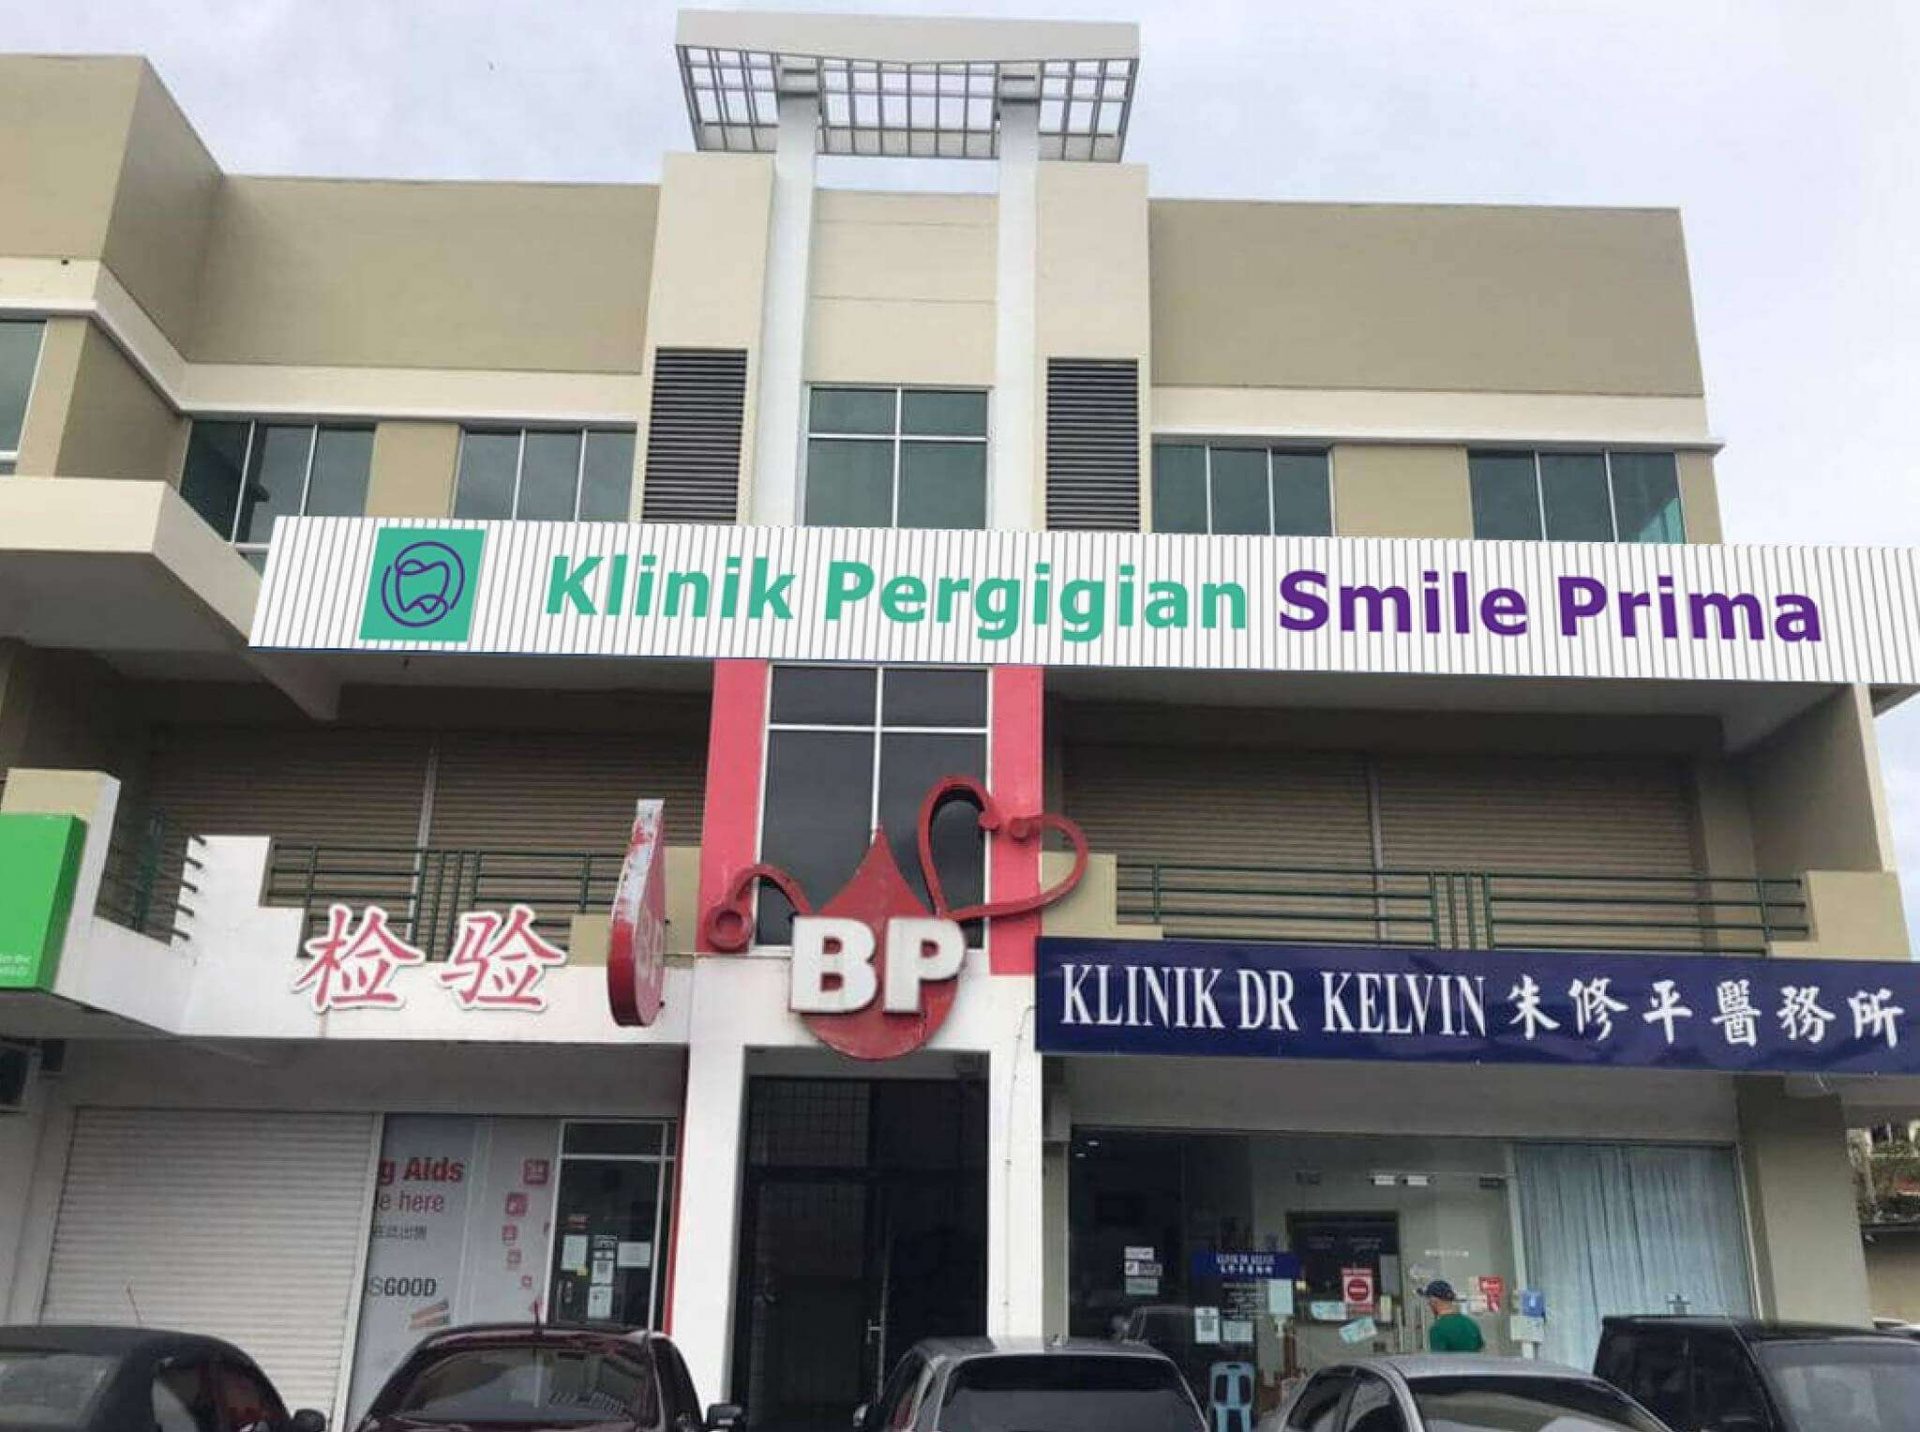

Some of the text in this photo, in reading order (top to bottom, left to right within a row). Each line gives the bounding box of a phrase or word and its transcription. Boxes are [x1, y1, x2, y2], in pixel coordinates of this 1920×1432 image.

[546, 554, 1822, 642] Klinik Pergigian Smile Prima
[295, 907, 565, 1006] 检验
[791, 916, 966, 1013] BP
[1061, 964, 1486, 1037] KLINIK DR KELVIN
[1507, 974, 1905, 1048] 朱修平醫務所
[400, 1191, 444, 1212] here
[404, 1157, 464, 1182] Aids
